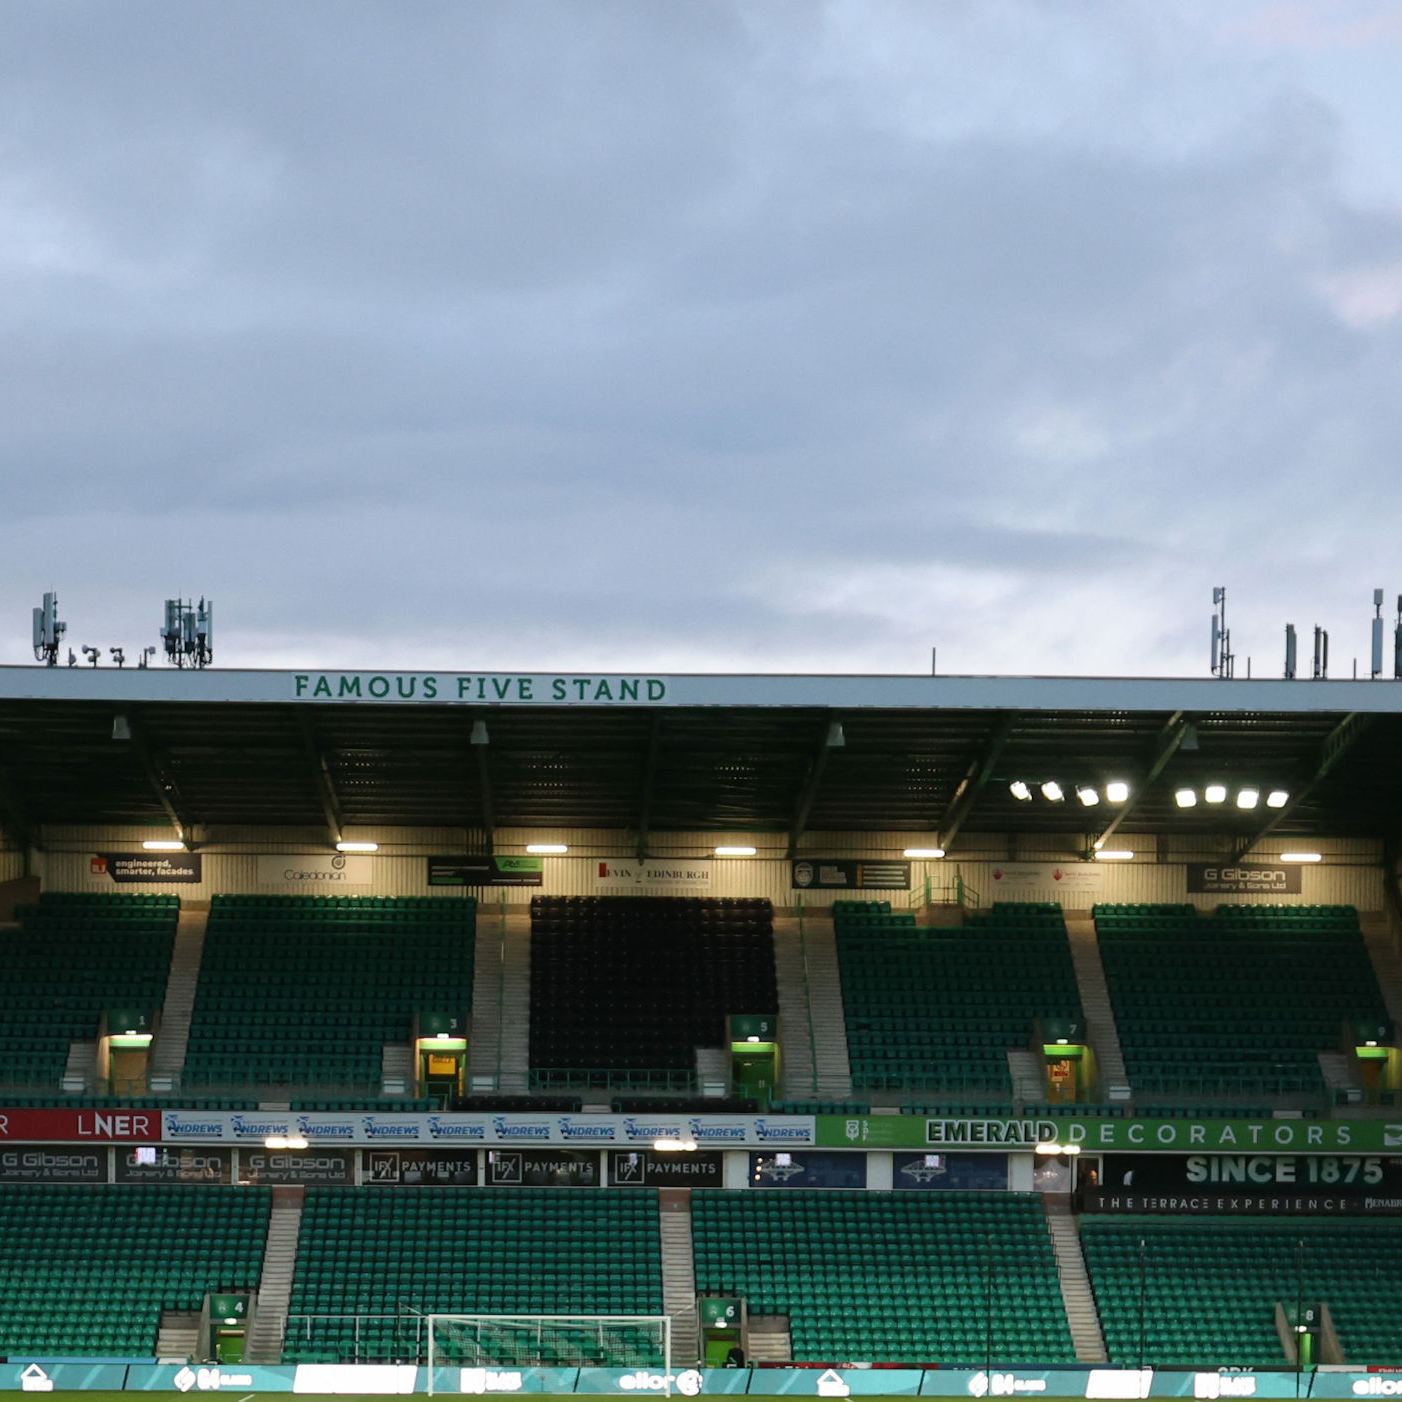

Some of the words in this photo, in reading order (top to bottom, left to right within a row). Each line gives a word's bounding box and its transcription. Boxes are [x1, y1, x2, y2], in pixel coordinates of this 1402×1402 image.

[294, 675, 438, 698] FAMOUS
[457, 677, 533, 699] FIVE
[552, 678, 666, 701] STAND
[115, 858, 172, 868] engineered,
[115, 867, 155, 876] smarter,
[157, 867, 195, 876] facades
[1203, 867, 1218, 881] G
[1221, 867, 1286, 881] Gibson
[78, 1111, 149, 1138] LNER
[926, 1119, 1059, 1144] EMERALD
[1070, 1124, 1351, 1145] DECORATORS
[2, 1153, 18, 1167] G
[23, 1152, 98, 1168] Gibson
[250, 1155, 265, 1169] G
[270, 1155, 345, 1169] Gibson
[402, 1161, 471, 1173] PAYMENTS
[524, 1161, 593, 1173] PAYMENTS
[647, 1163, 717, 1174] PAYMENTS
[1186, 1156, 1297, 1183] SINCE
[1306, 1158, 1384, 1184] 1875
[2, 1169, 41, 1180] Joinery
[43, 1170, 50, 1178] &
[84, 1169, 99, 1178] Ltd
[1099, 1198, 1133, 1209] THE
[1142, 1198, 1209, 1209] TERRACE
[1217, 1198, 1347, 1210] EXPERIENCE
[235, 1302, 244, 1313] 4
[726, 1306, 735, 1317] 6
[1306, 1309, 1314, 1321] 8
